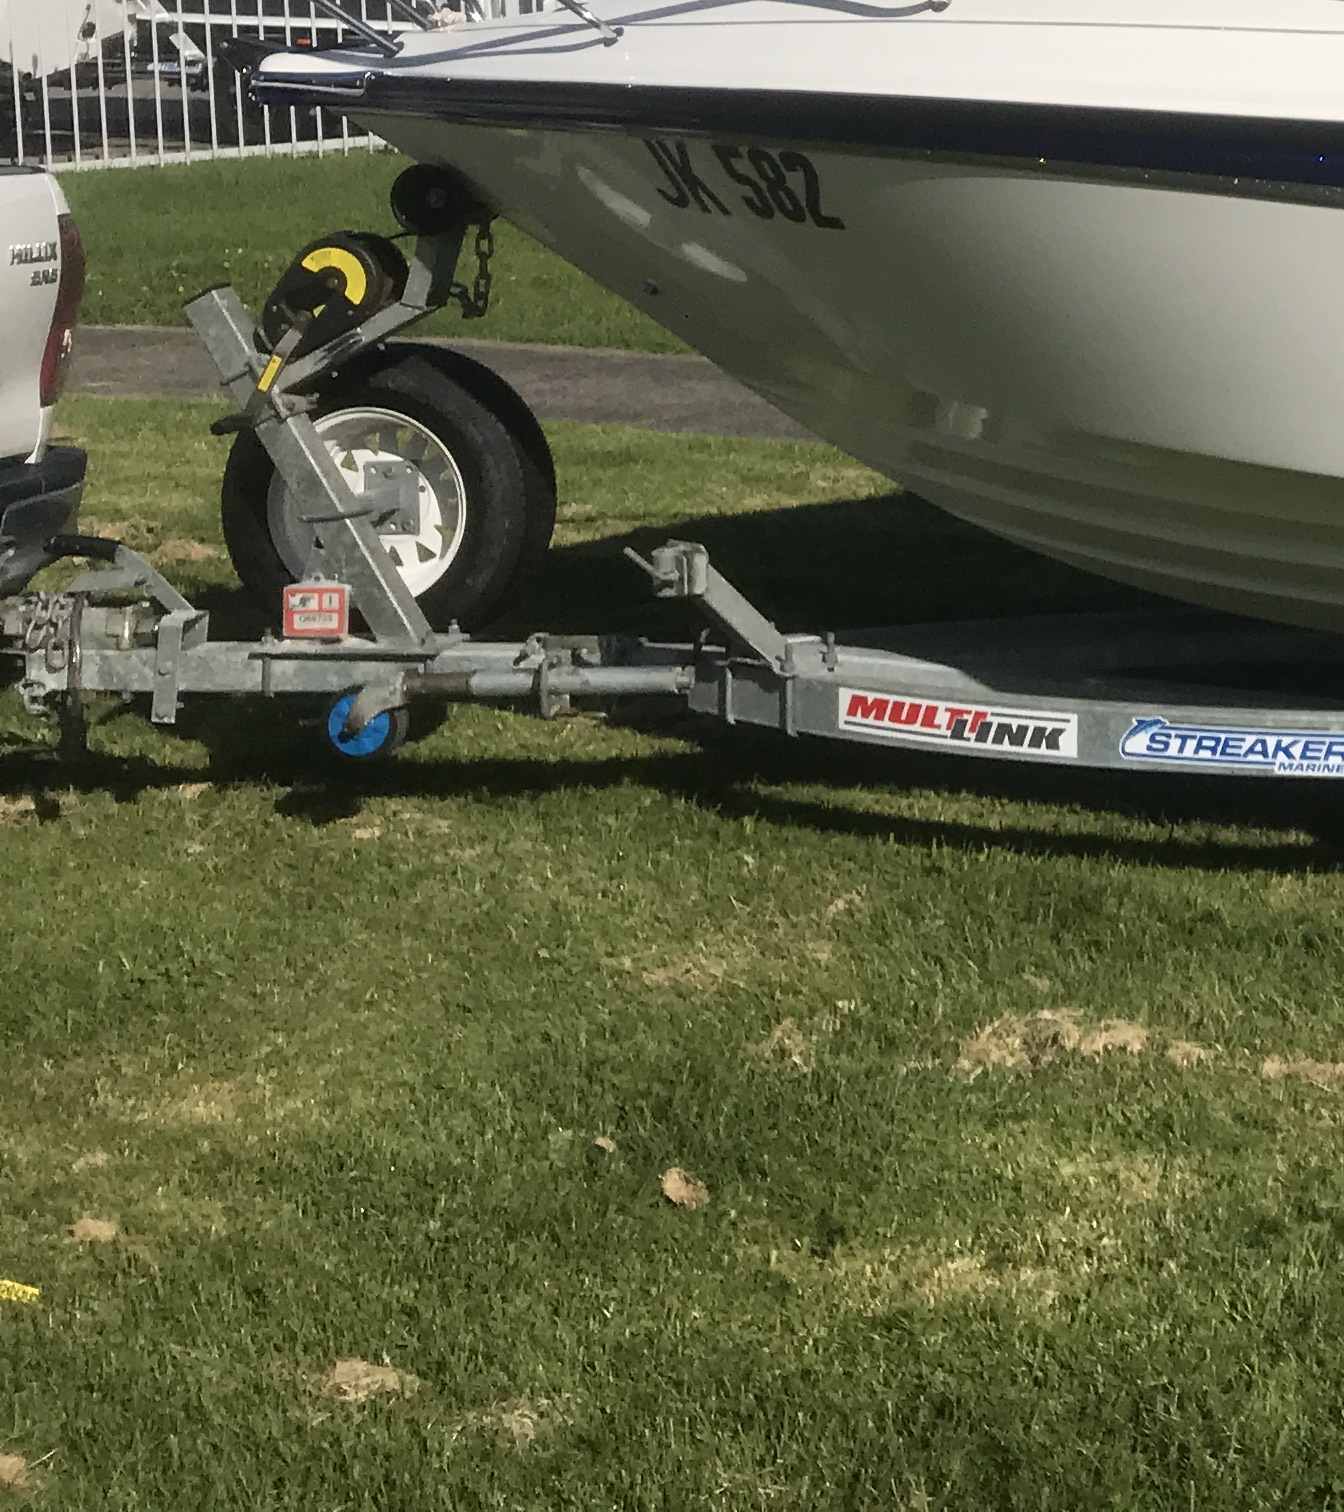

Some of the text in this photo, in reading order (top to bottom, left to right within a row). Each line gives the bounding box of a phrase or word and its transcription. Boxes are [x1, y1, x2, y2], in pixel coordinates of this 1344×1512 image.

[643, 139, 846, 230] JK 582
[846, 694, 989, 734] MULTI
[950, 718, 1067, 752] LINK
